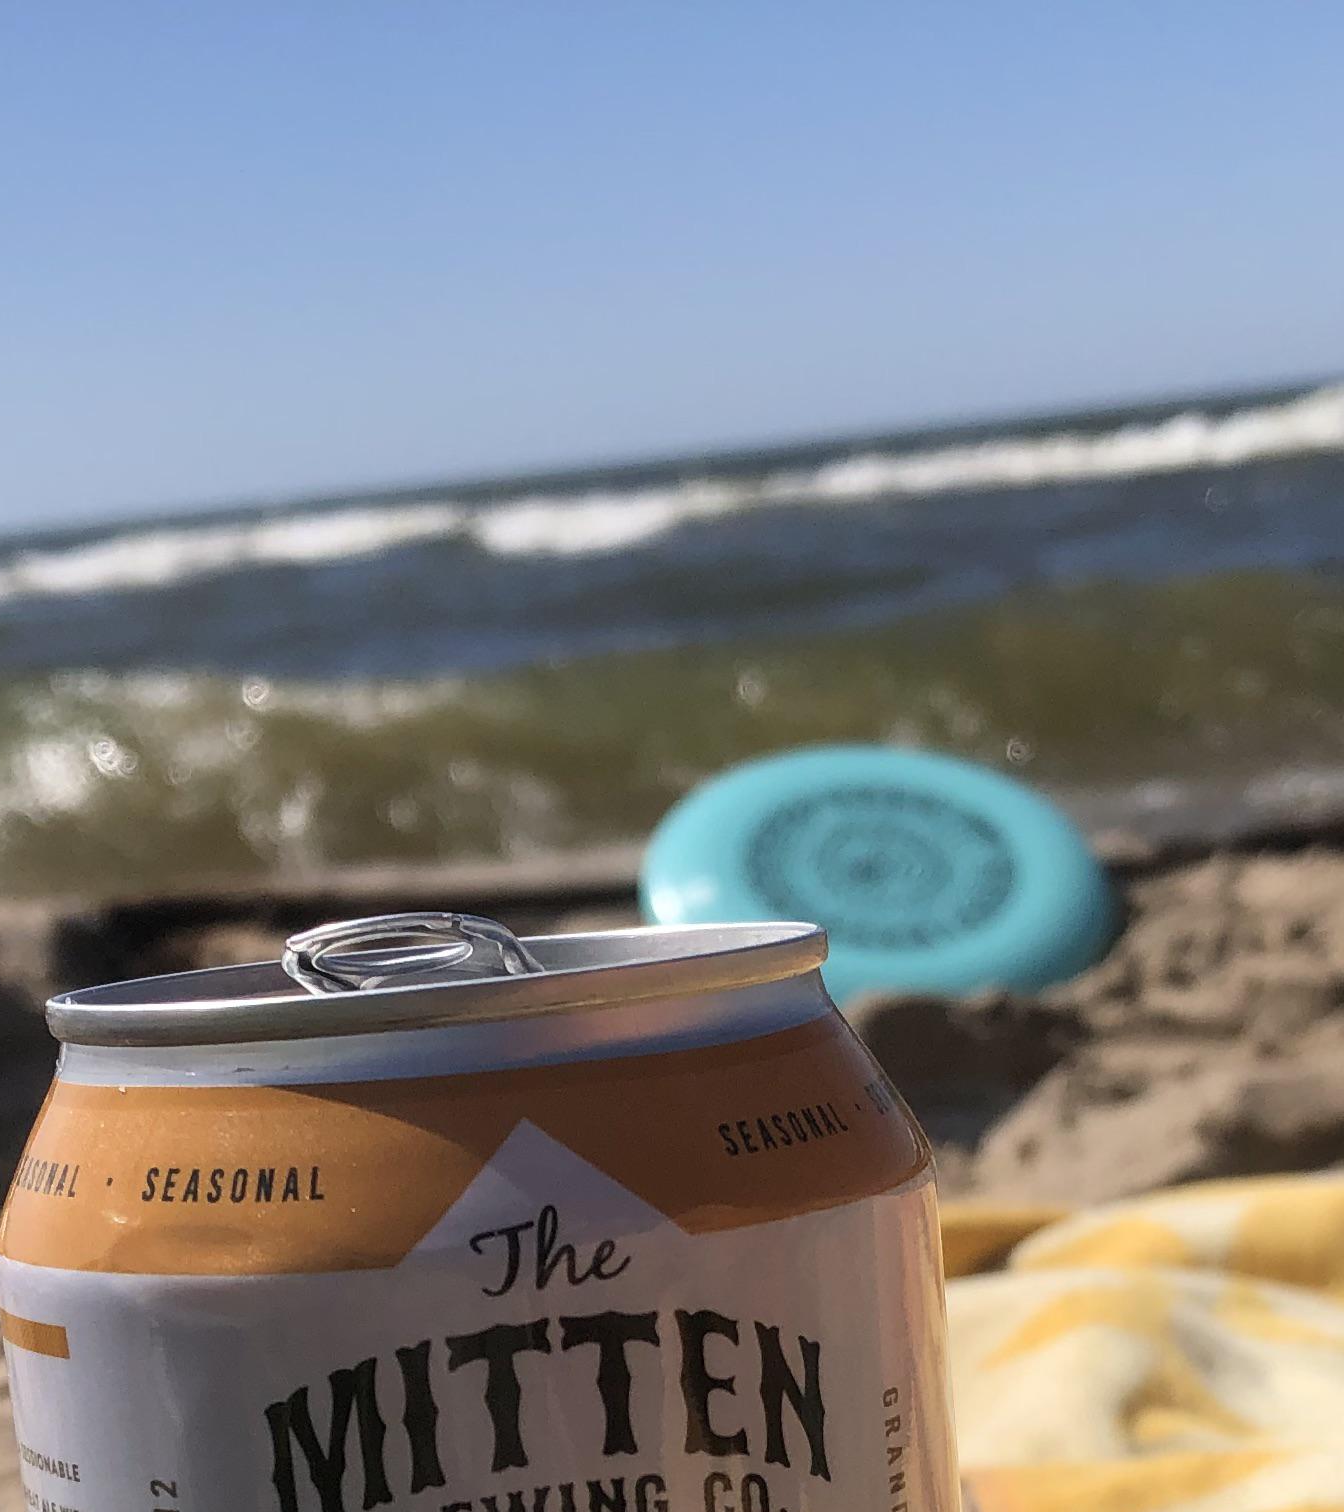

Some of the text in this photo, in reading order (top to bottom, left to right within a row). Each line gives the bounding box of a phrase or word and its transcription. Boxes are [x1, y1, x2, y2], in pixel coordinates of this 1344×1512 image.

[717, 1102, 849, 1157] SEASONAL
[141, 1166, 325, 1204] SEASONAL
[468, 1205, 632, 1297] The
